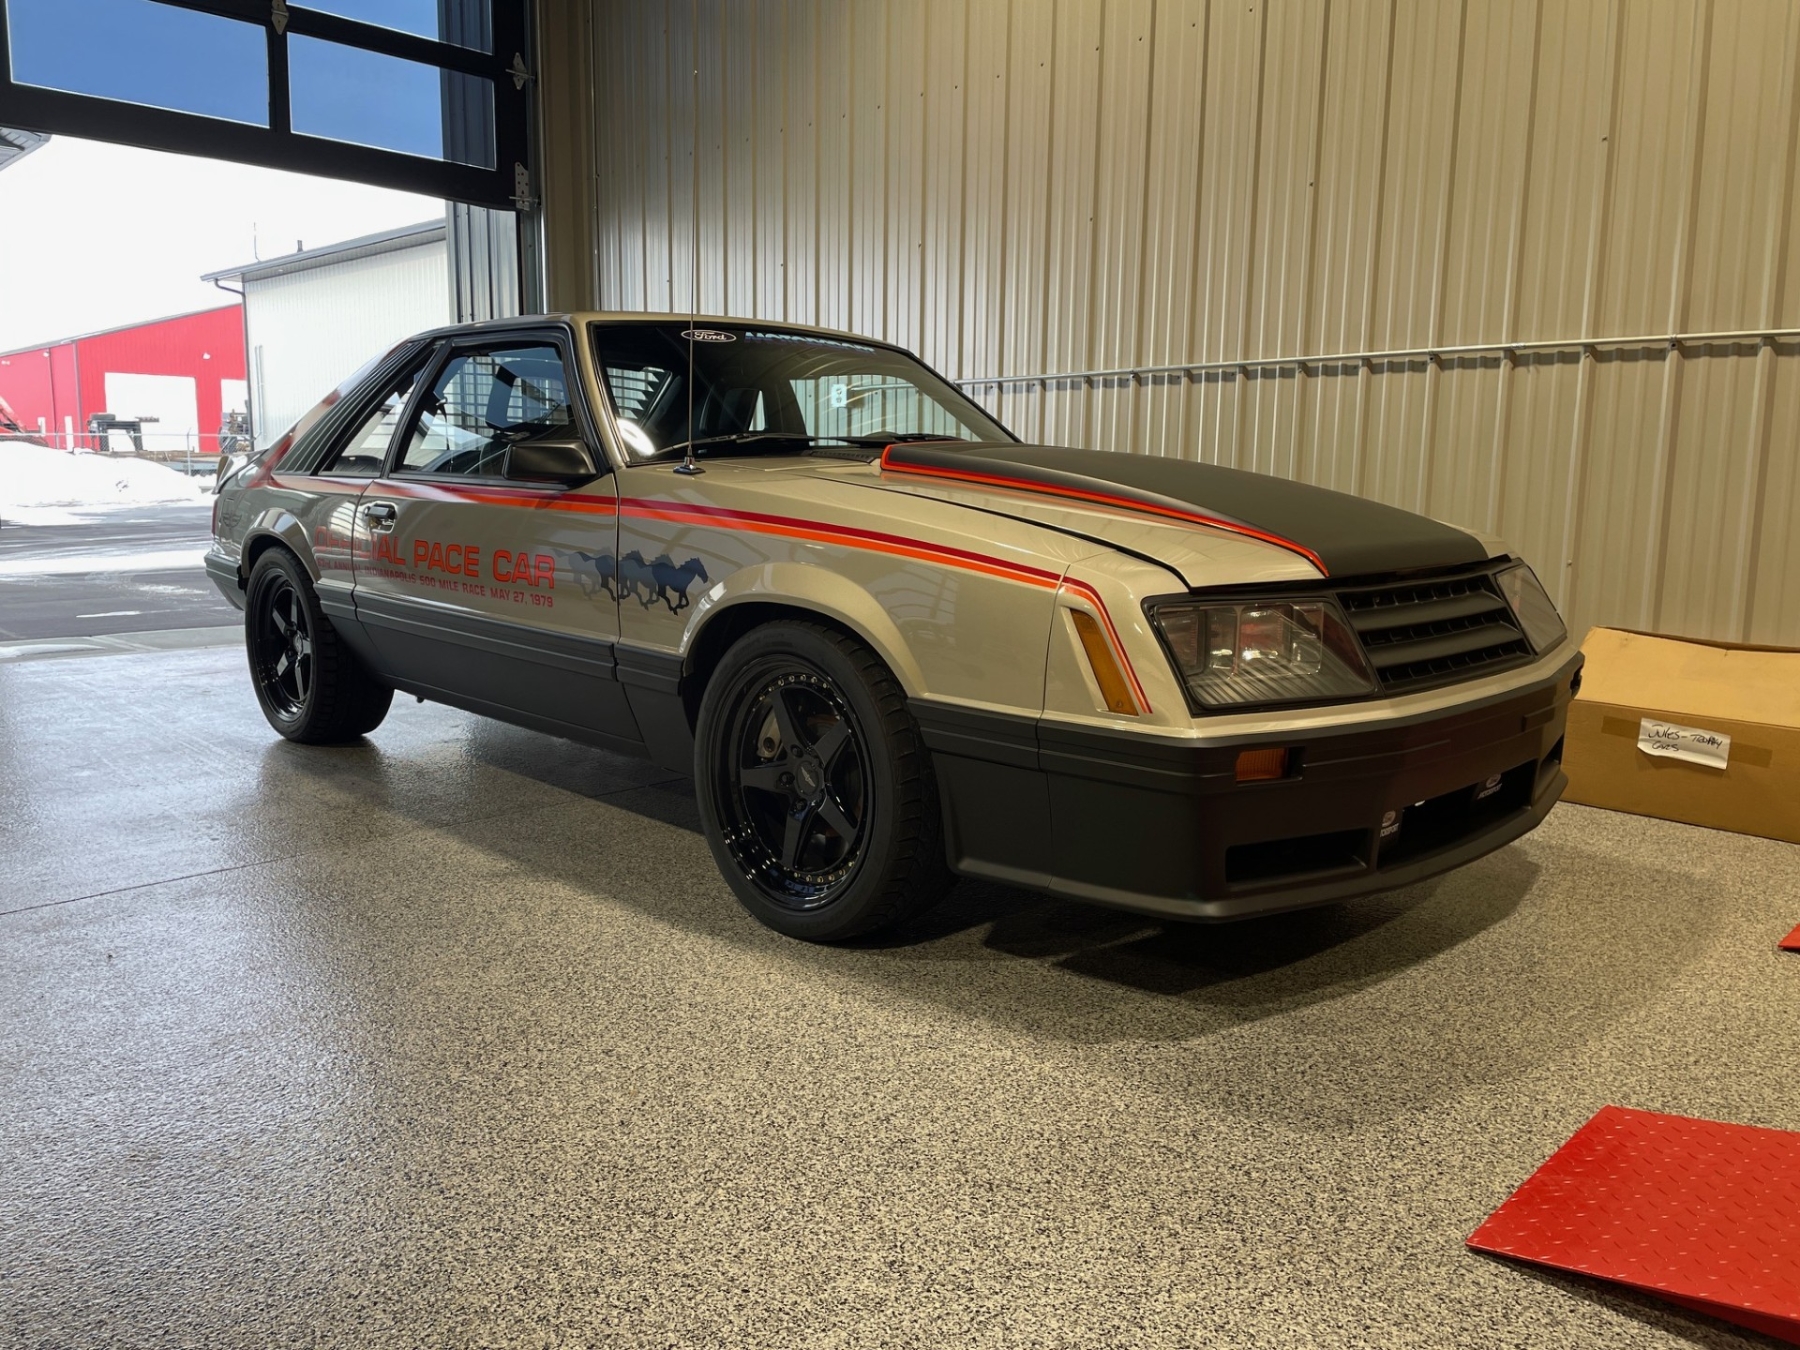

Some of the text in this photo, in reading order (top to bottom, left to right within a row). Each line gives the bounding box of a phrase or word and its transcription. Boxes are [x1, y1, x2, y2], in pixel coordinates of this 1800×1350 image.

[692, 331, 728, 341] Ford
[413, 539, 480, 578] PACE
[493, 549, 556, 589] CAR
[364, 565, 416, 584] INDIANAPOLIS
[419, 576, 436, 587] 500
[438, 579, 459, 591] MILE
[462, 583, 486, 597] RACE
[490, 587, 510, 601] MAY
[513, 591, 528, 605] 27,
[530, 593, 553, 608] 1979
